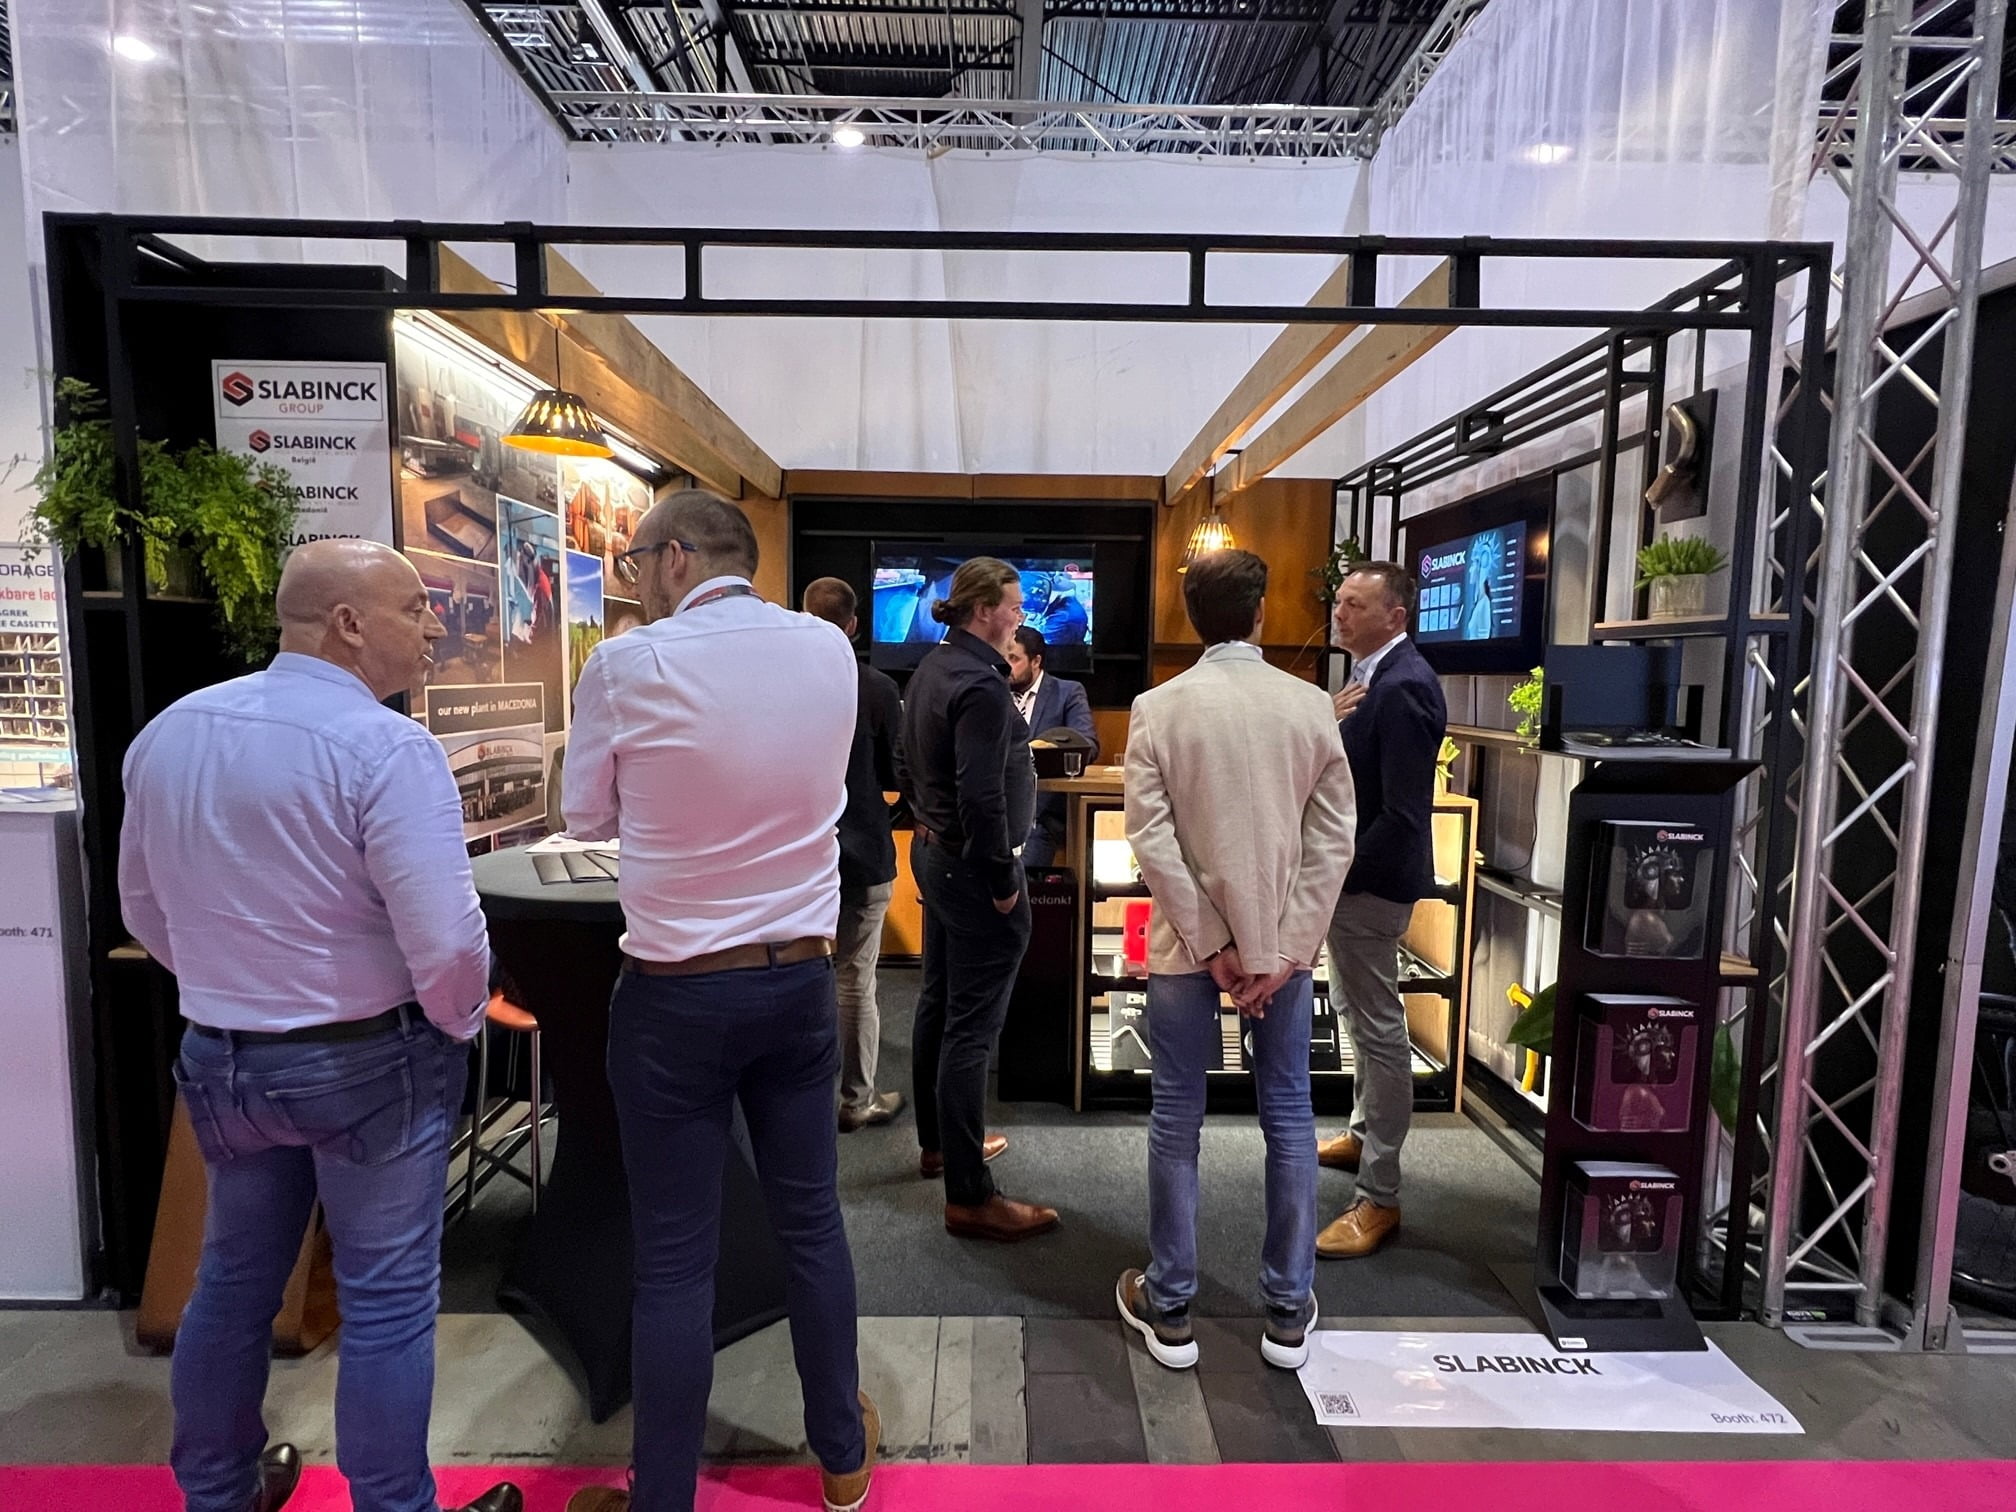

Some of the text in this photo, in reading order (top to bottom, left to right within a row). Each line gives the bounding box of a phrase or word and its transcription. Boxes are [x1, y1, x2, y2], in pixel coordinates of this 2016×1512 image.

[258, 379, 378, 402] SLABINCK
[279, 403, 324, 414] GROUP
[273, 435, 356, 450] SLABINCK
[1431, 550, 1467, 572] SLABINCK
[438, 706, 451, 716] our
[453, 705, 469, 715] new
[471, 701, 489, 717] plant
[489, 700, 497, 712] in
[1668, 832, 1705, 841] SLABINCK
[1030, 895, 1072, 905] edankt
[30, 927, 53, 938] 471
[1658, 1010, 1695, 1018] SLABINCK
[1640, 1182, 1676, 1190] SLABINCK
[1432, 1354, 1603, 1376] SLABINCK
[1710, 1412, 1788, 1424] Booth: 472
